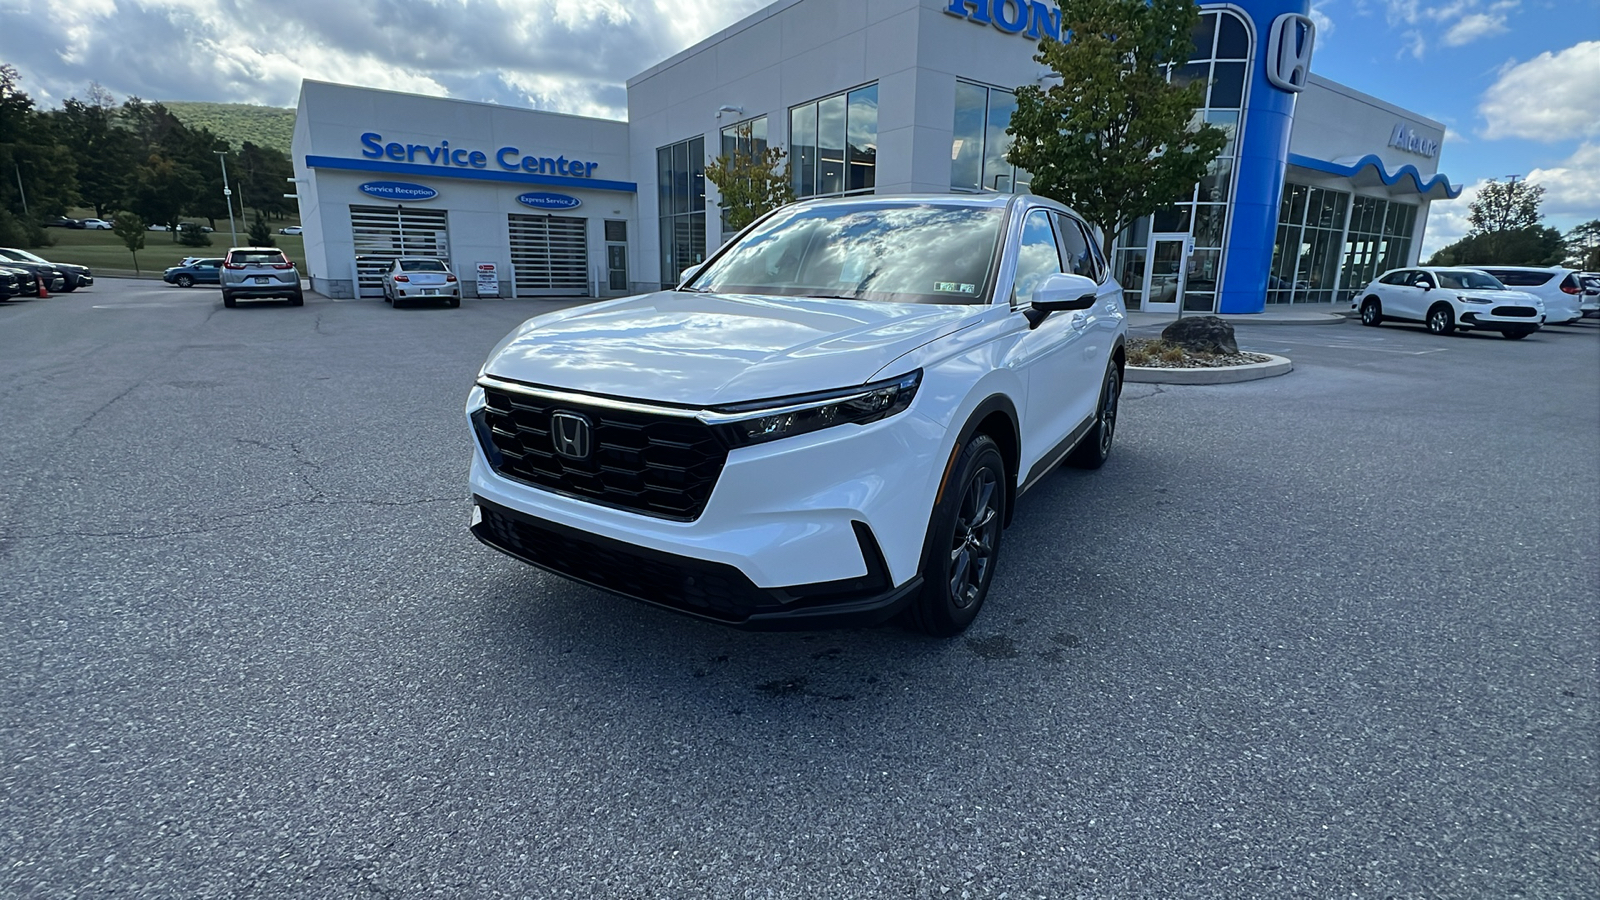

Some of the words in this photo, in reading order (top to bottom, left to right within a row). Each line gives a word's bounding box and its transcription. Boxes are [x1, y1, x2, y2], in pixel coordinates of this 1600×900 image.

[944, 0, 1074, 44] HON
[360, 132, 487, 168] Service
[496, 147, 599, 177] Center
[364, 184, 394, 193] Service
[395, 187, 433, 195] Reception
[520, 195, 545, 203] Express
